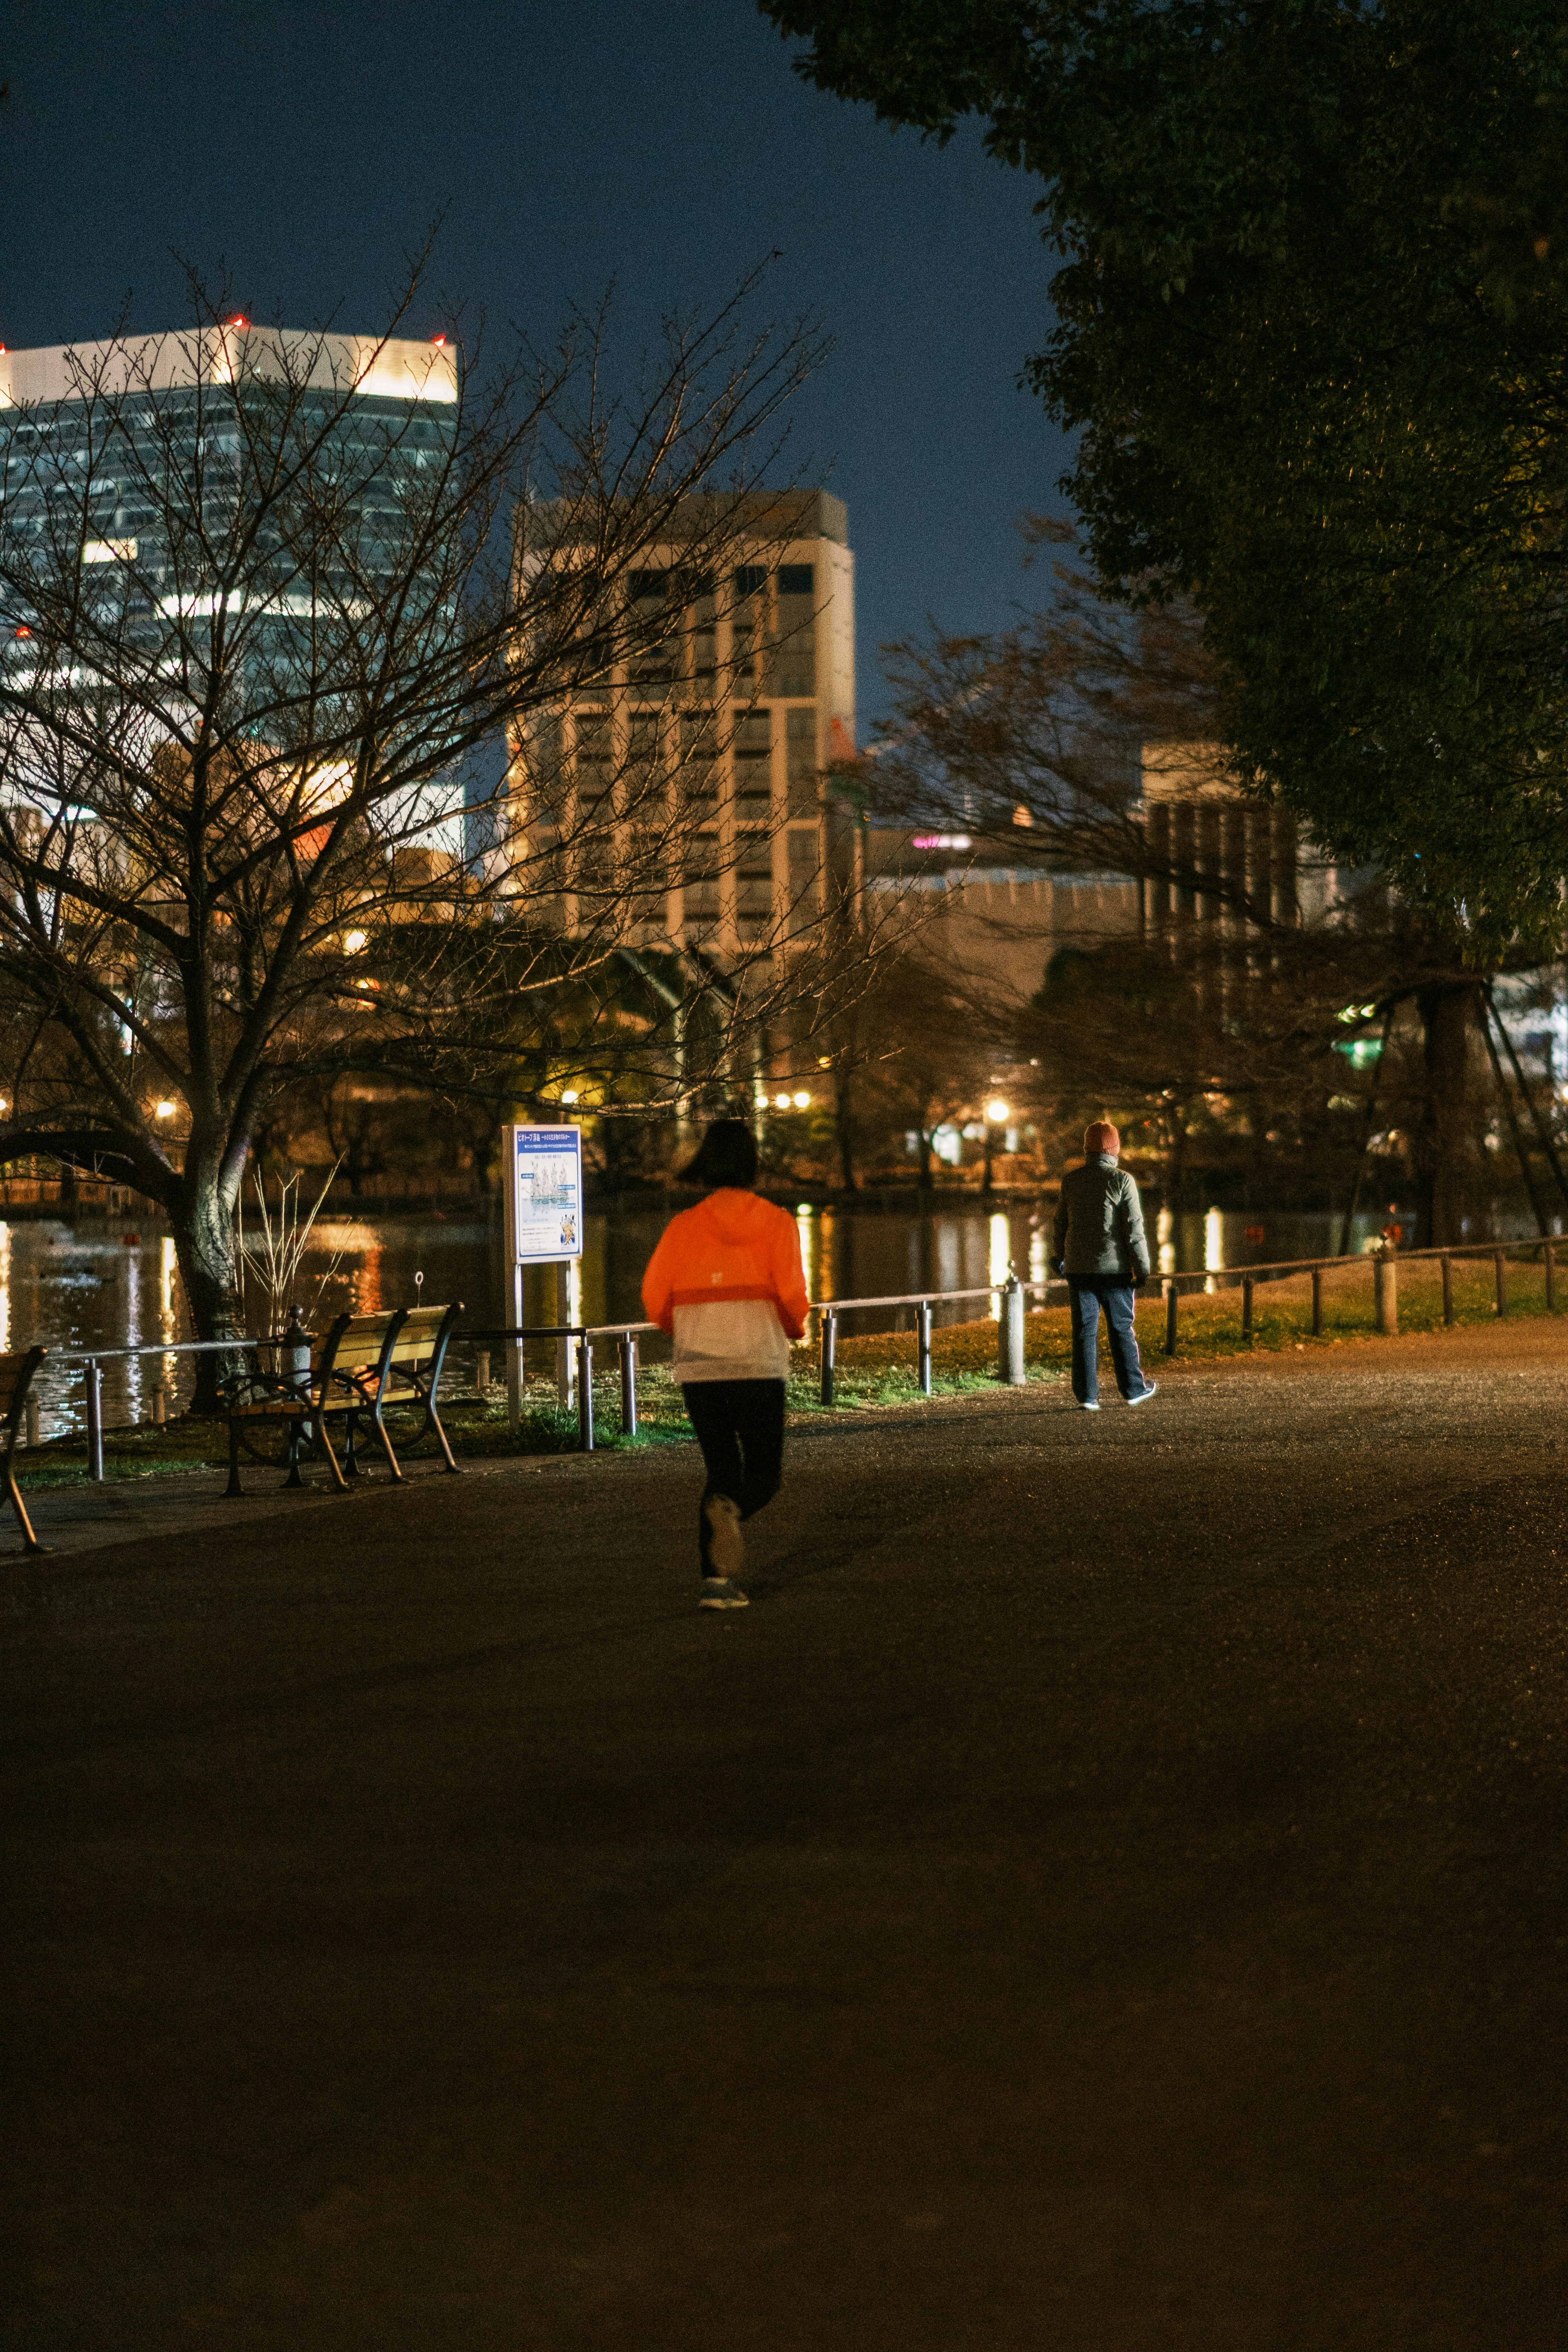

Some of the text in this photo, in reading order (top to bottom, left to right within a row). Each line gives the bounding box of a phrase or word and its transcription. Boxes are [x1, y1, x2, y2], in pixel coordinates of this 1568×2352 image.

[518, 1133, 540, 1142] ビオトープ浮島
